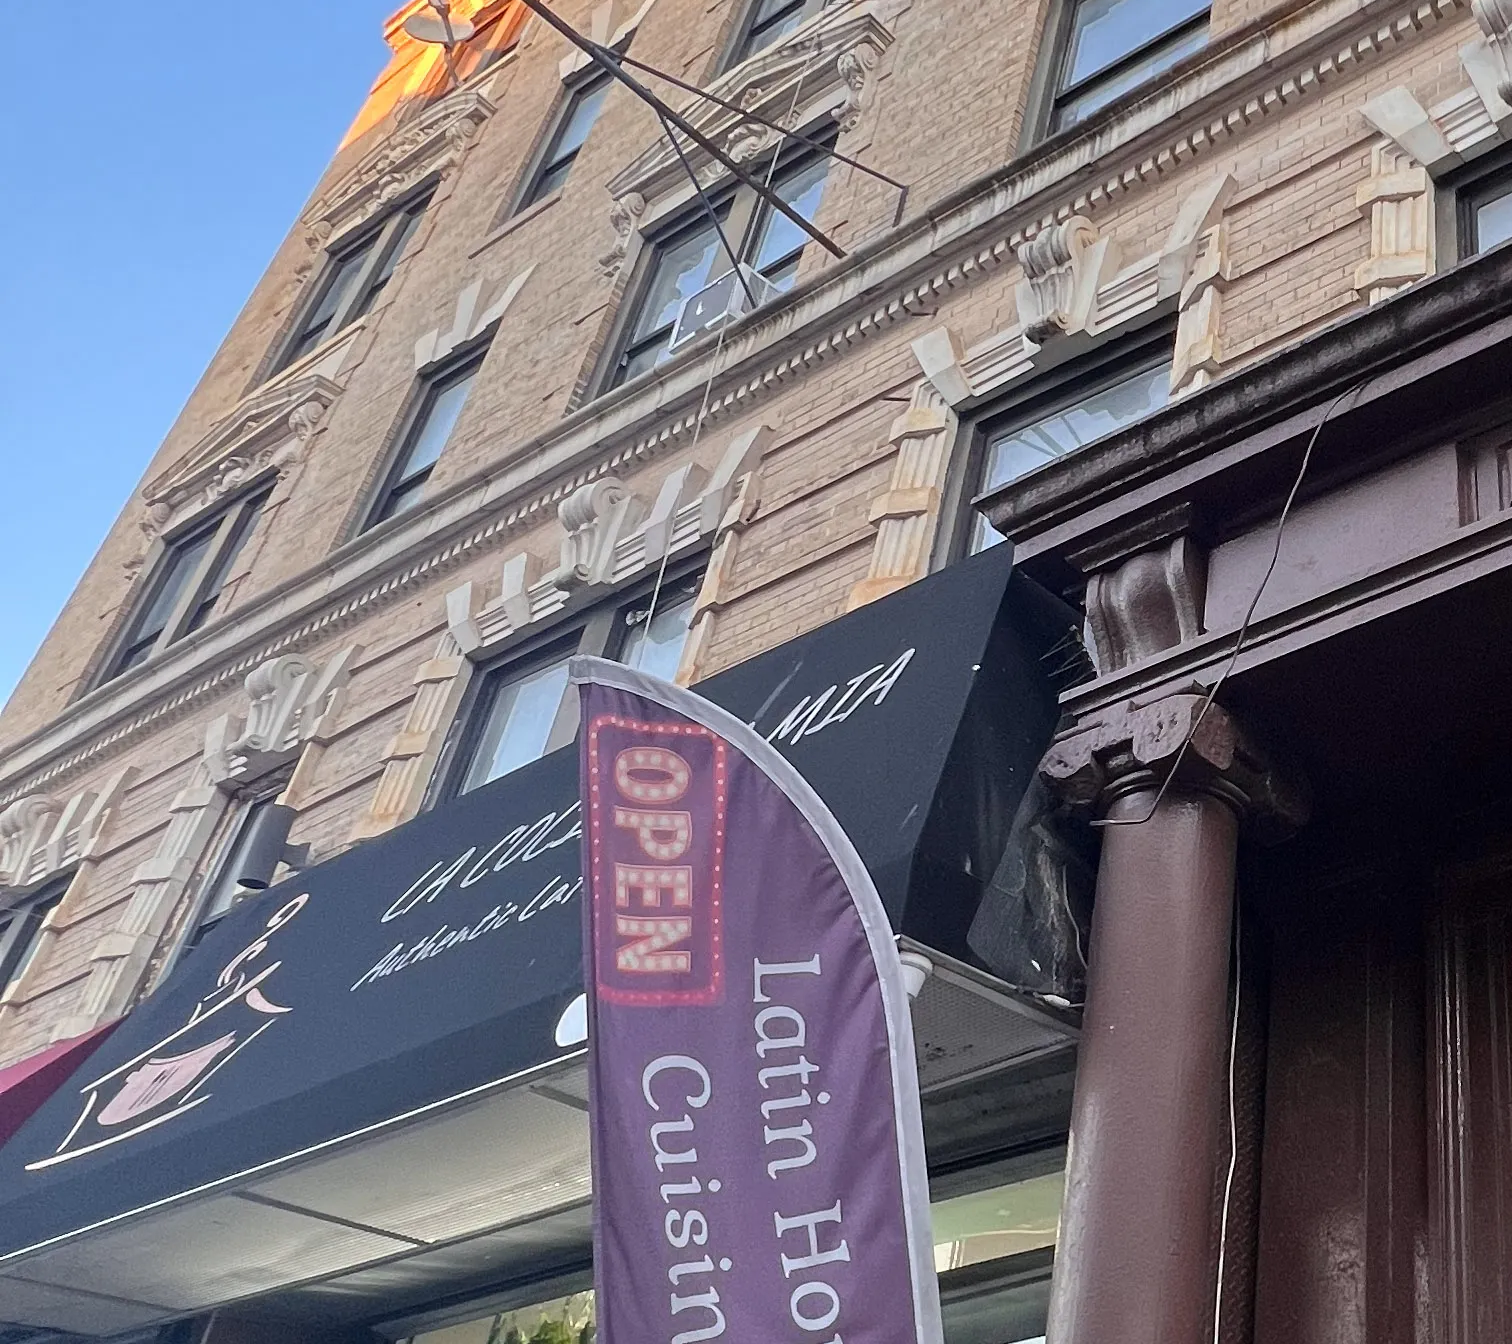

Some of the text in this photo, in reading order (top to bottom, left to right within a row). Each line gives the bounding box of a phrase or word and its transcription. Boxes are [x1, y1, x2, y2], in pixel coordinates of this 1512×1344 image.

[380, 846, 477, 924] LA
[765, 647, 916, 746] MIA
[614, 746, 692, 974] OPEN
[350, 902, 518, 992] Authentic
[752, 953, 831, 1180] Latin
